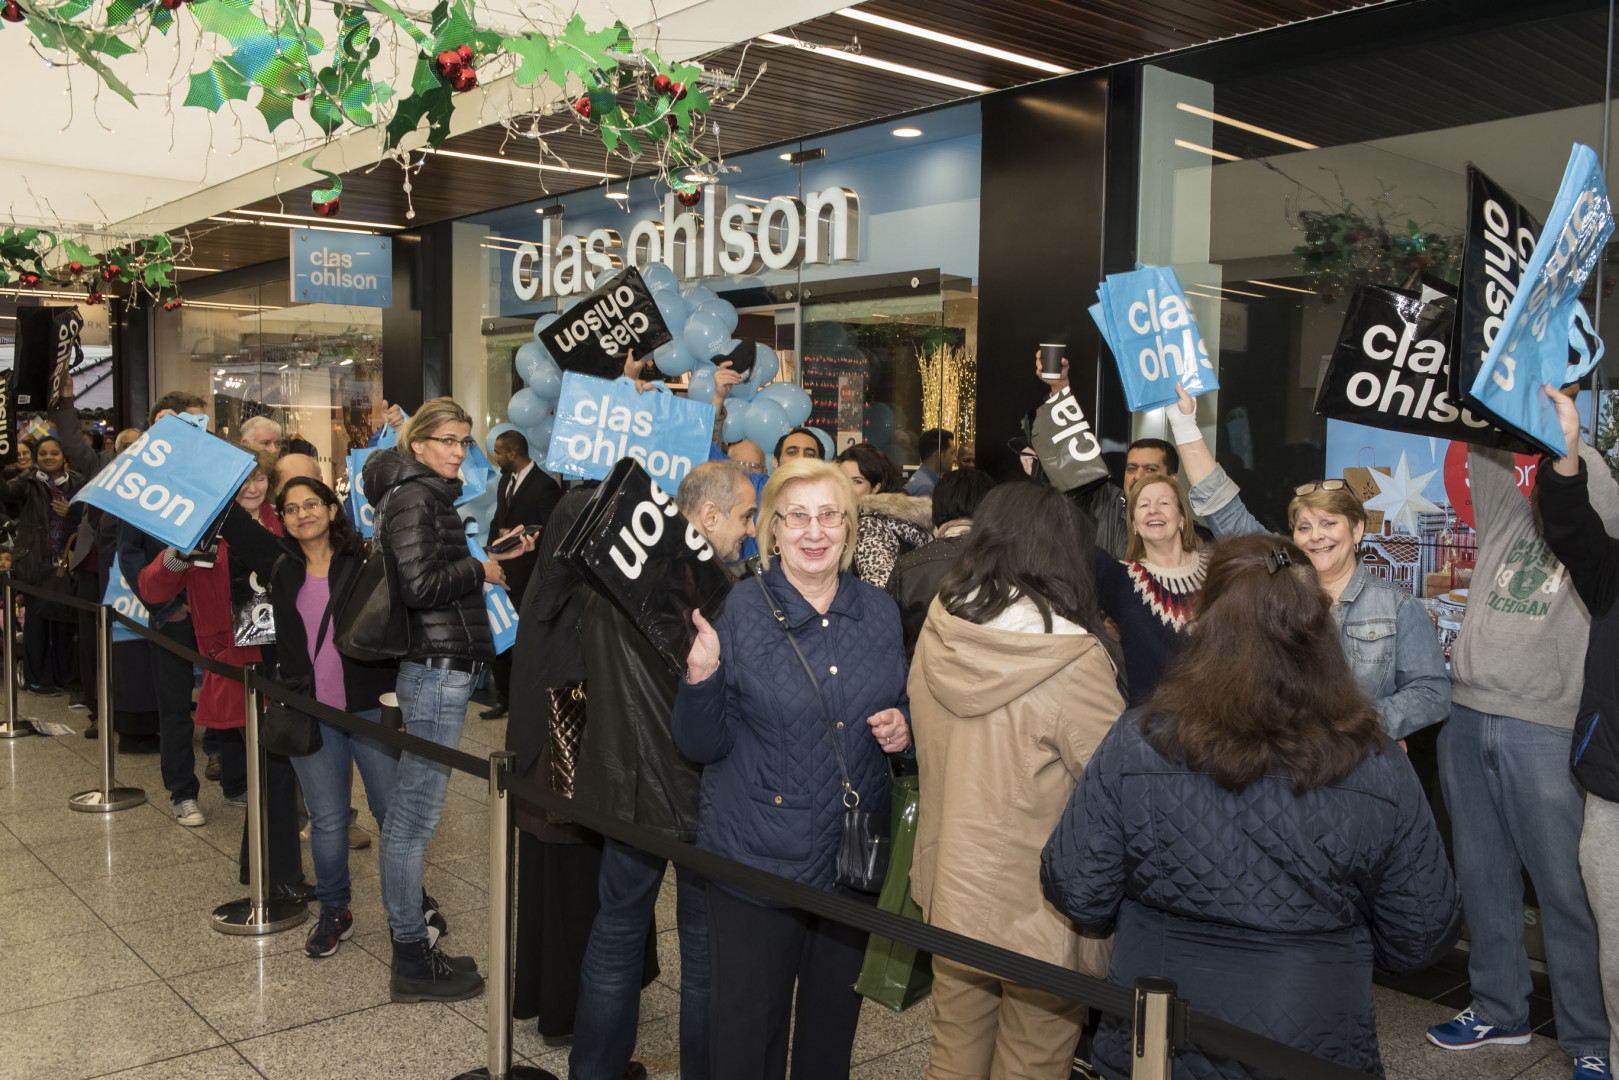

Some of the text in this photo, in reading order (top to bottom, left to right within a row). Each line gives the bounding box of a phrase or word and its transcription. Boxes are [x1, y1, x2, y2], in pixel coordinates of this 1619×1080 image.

[310, 247, 353, 268] clas
[513, 184, 860, 301] clas ohlson
[310, 267, 377, 290] ohlson
[554, 285, 635, 353] ohlson
[600, 312, 649, 356] clas
[1128, 289, 1198, 335] cla
[1362, 322, 1450, 377] cla
[574, 395, 653, 437] clas
[568, 430, 691, 480] ohlson
